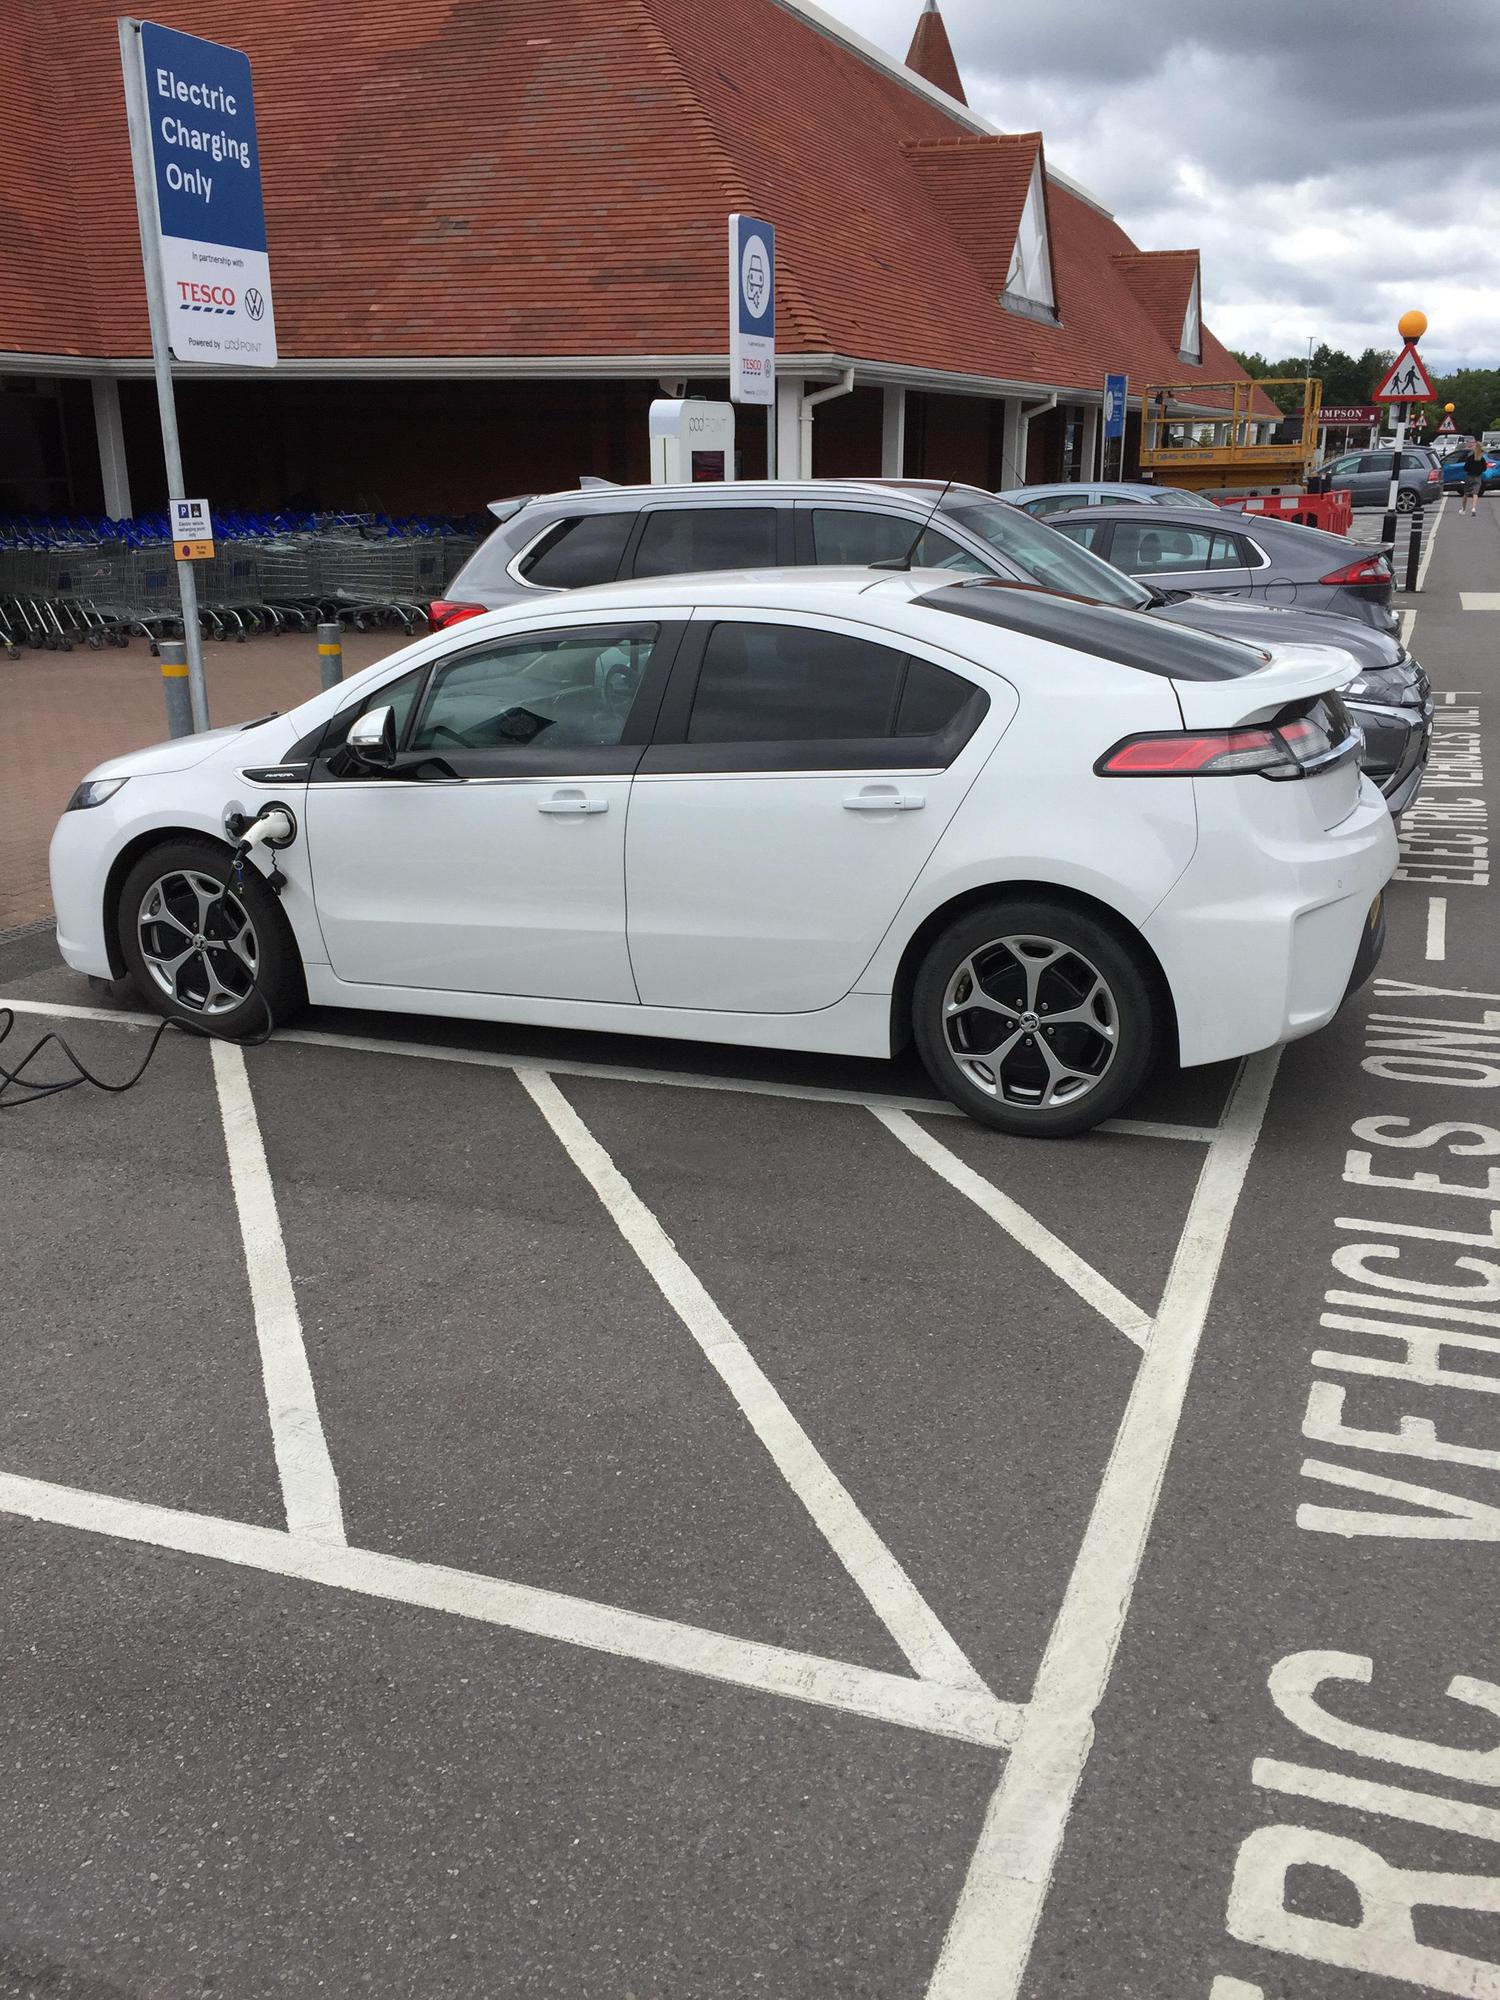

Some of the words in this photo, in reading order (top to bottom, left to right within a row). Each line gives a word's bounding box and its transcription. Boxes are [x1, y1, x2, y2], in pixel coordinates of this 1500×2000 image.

[157, 68, 237, 115] Electric
[161, 117, 250, 168] Charging
[166, 163, 212, 203] Only
[199, 254, 232, 266] partnership
[177, 281, 235, 306] TESCO
[189, 337, 213, 348] Powered
[742, 358, 761, 371] TESCO
[1316, 410, 1363, 418] IMPSON
[1392, 797, 1490, 886] ELECTRIC
[1360, 978, 1500, 1088] ONLY
[1295, 1115, 1500, 1541] VEHICLES
